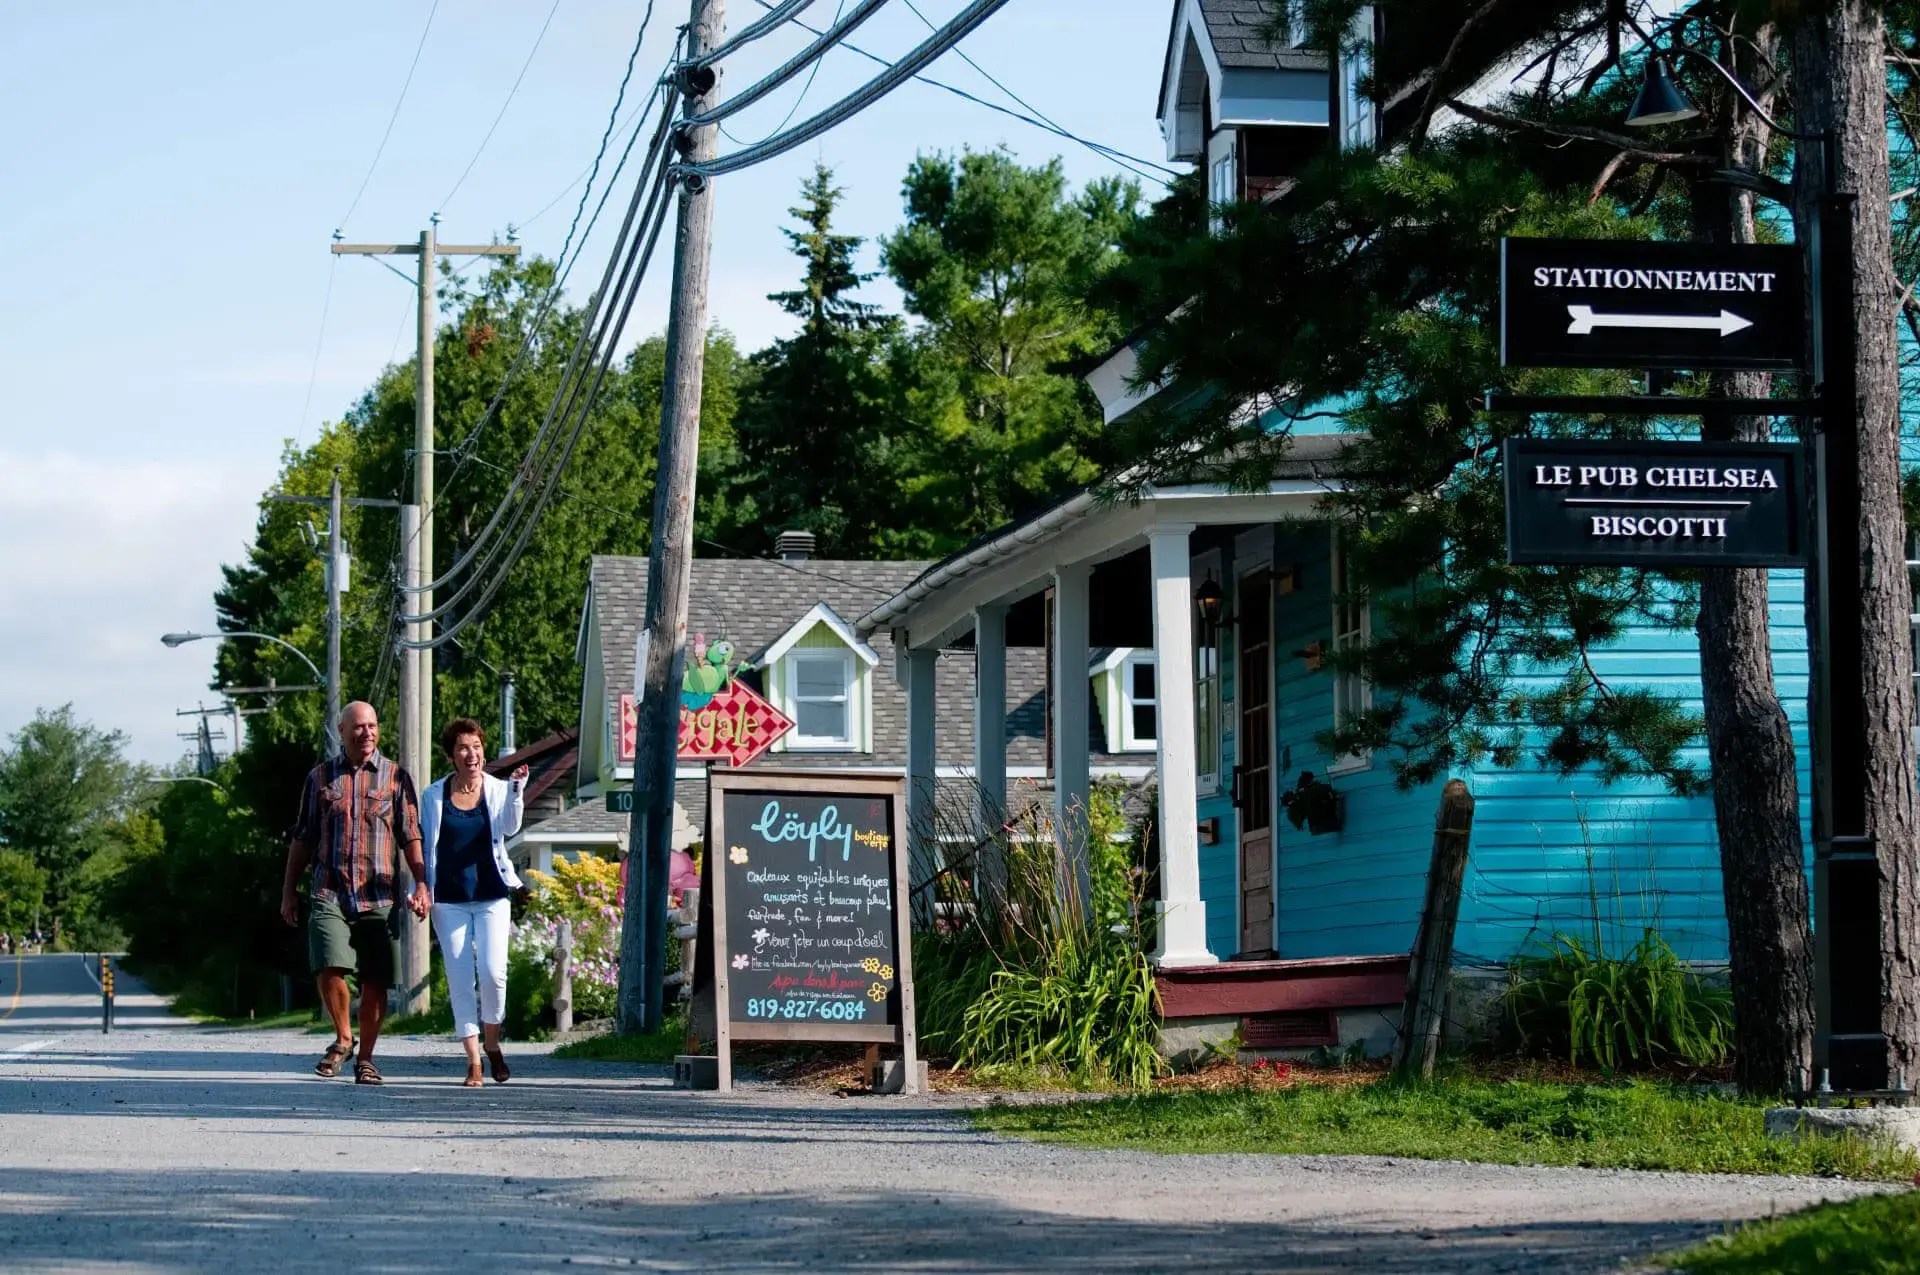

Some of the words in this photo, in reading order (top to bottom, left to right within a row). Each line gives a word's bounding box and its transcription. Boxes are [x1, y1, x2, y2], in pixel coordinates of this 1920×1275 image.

[1533, 267, 1776, 293] STATIONNEMENT
[1535, 465, 1572, 486] LE
[1580, 466, 1638, 488] PUB
[1646, 467, 1778, 489] CHELSEA
[1591, 516, 1728, 538] BISCOTTI
[751, 800, 852, 862] löyly
[853, 873, 889, 895] uniques
[813, 890, 826, 907] et
[794, 907, 812, 922] fun
